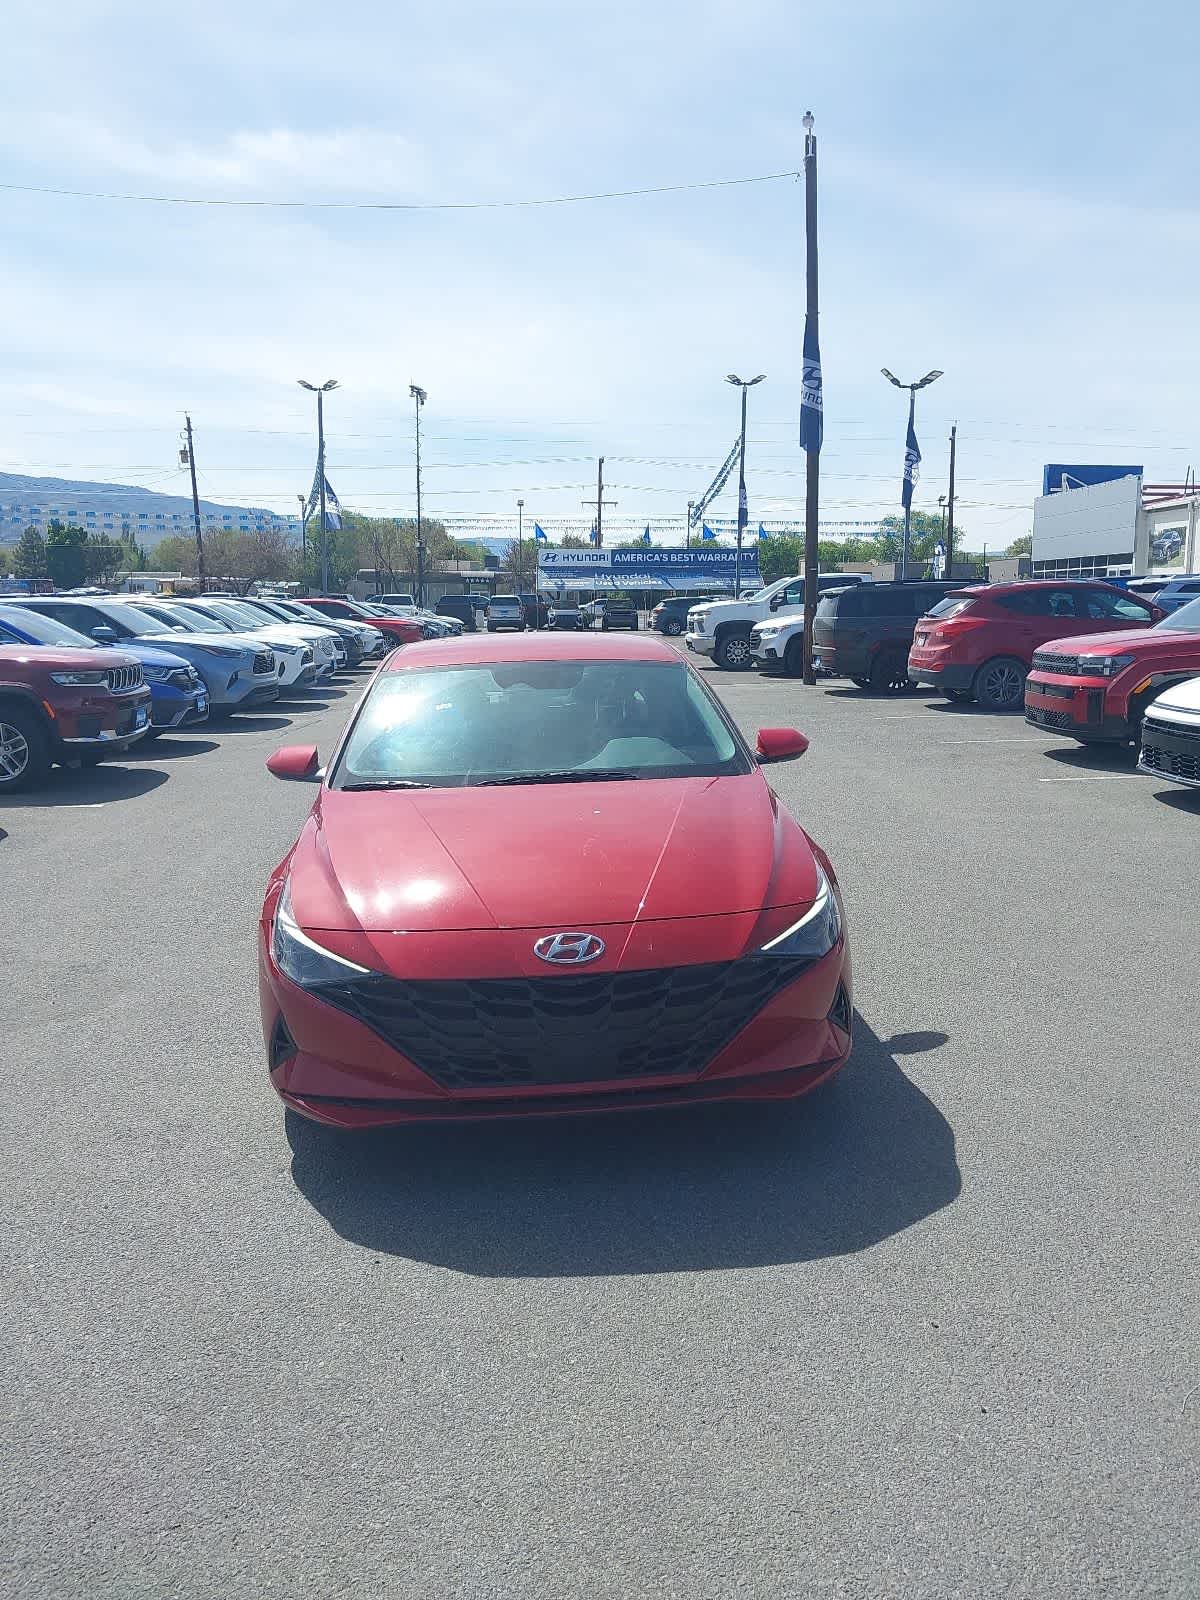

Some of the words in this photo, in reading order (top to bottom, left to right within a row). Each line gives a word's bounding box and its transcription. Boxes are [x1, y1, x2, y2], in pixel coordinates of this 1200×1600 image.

[562, 553, 609, 562] HYUNDAI
[614, 553, 669, 563] AMERICA'S
[670, 552, 696, 562] BEST
